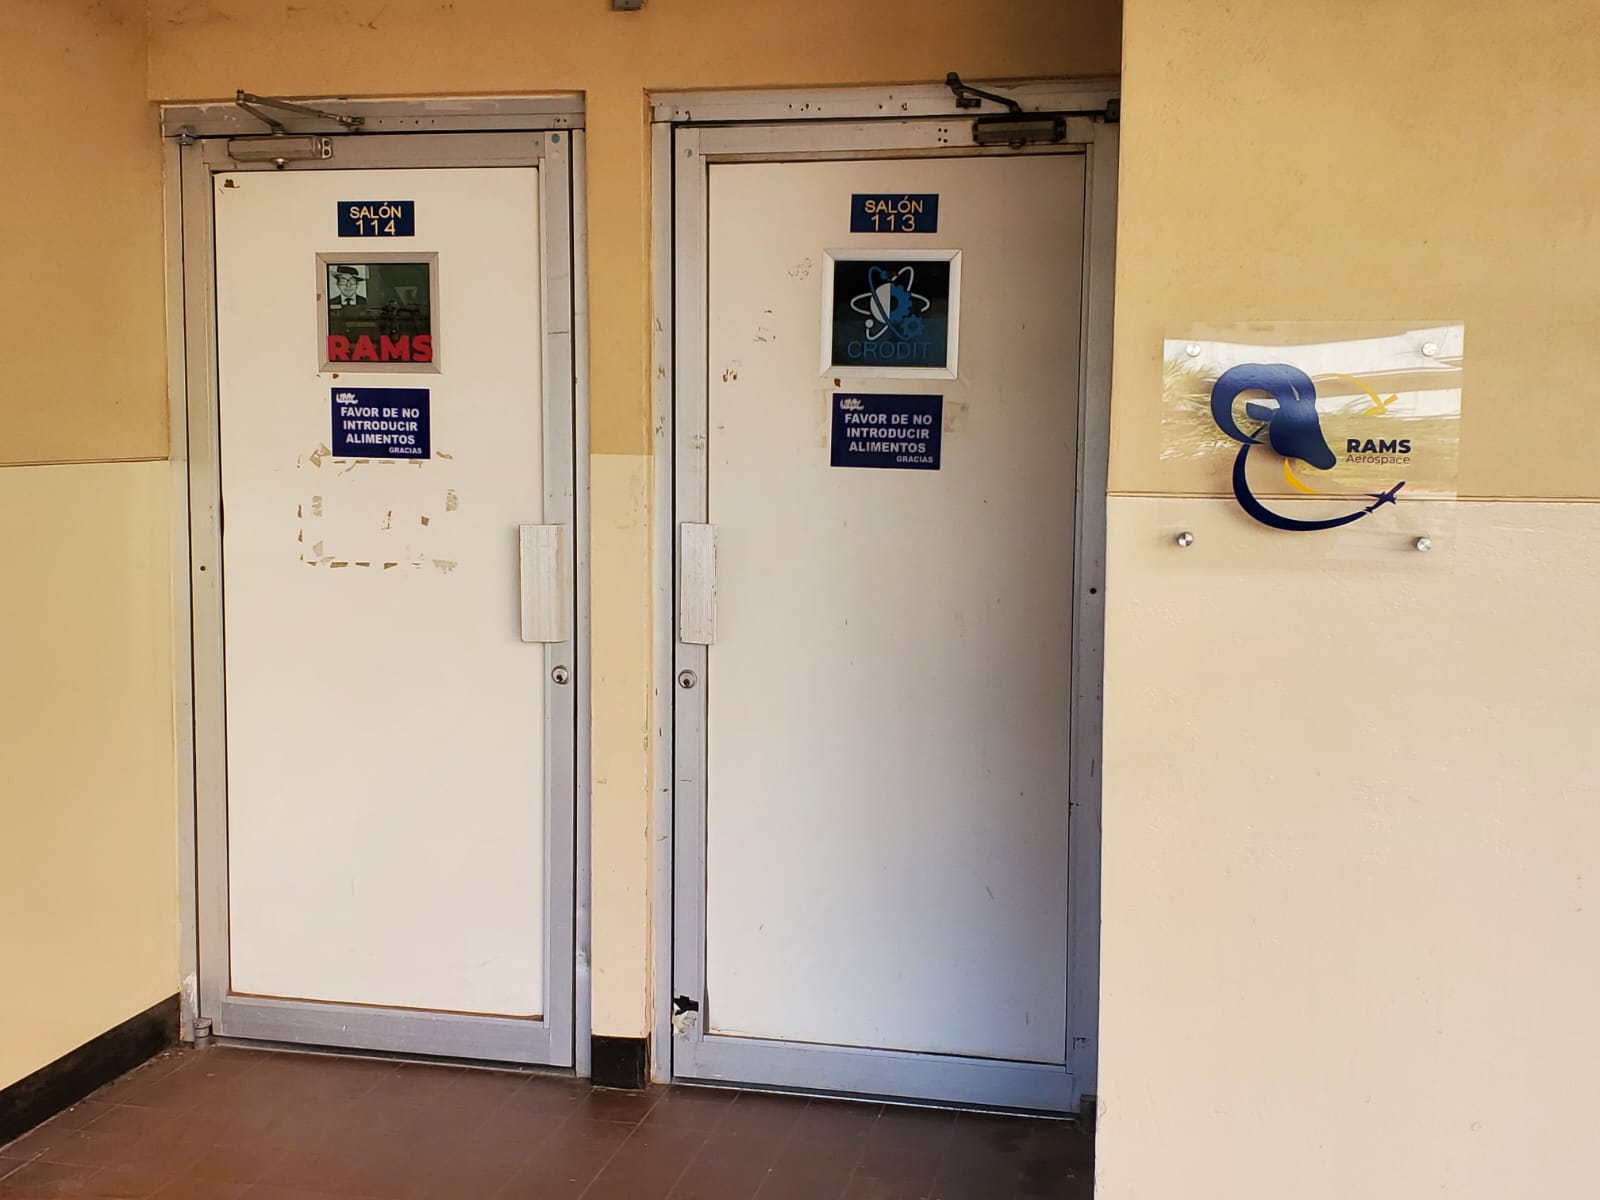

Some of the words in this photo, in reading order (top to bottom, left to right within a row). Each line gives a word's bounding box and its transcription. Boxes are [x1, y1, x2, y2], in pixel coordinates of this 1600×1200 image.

[349, 202, 402, 219] SALÓN
[864, 196, 923, 214] SALÓN
[355, 219, 396, 236] 114
[870, 214, 915, 232] 113
[327, 334, 433, 362] RAMS
[847, 340, 932, 360] CRODIT
[340, 406, 380, 418] FAVOR
[382, 407, 399, 418] DE
[402, 408, 420, 418] NO
[844, 413, 887, 425] FAVOR
[891, 414, 909, 425] DE
[912, 414, 933, 425] NO
[343, 420, 418, 432] INTRODUCIR
[345, 433, 416, 445] ALIMENTOS
[846, 427, 930, 439] INTRODUCIR
[388, 446, 423, 454] GRACIAS
[848, 441, 926, 453] ALIMENTOS
[1346, 438, 1411, 454] RAMS
[896, 455, 934, 463] GRACIAS
[1345, 454, 1411, 466] Aerospace
